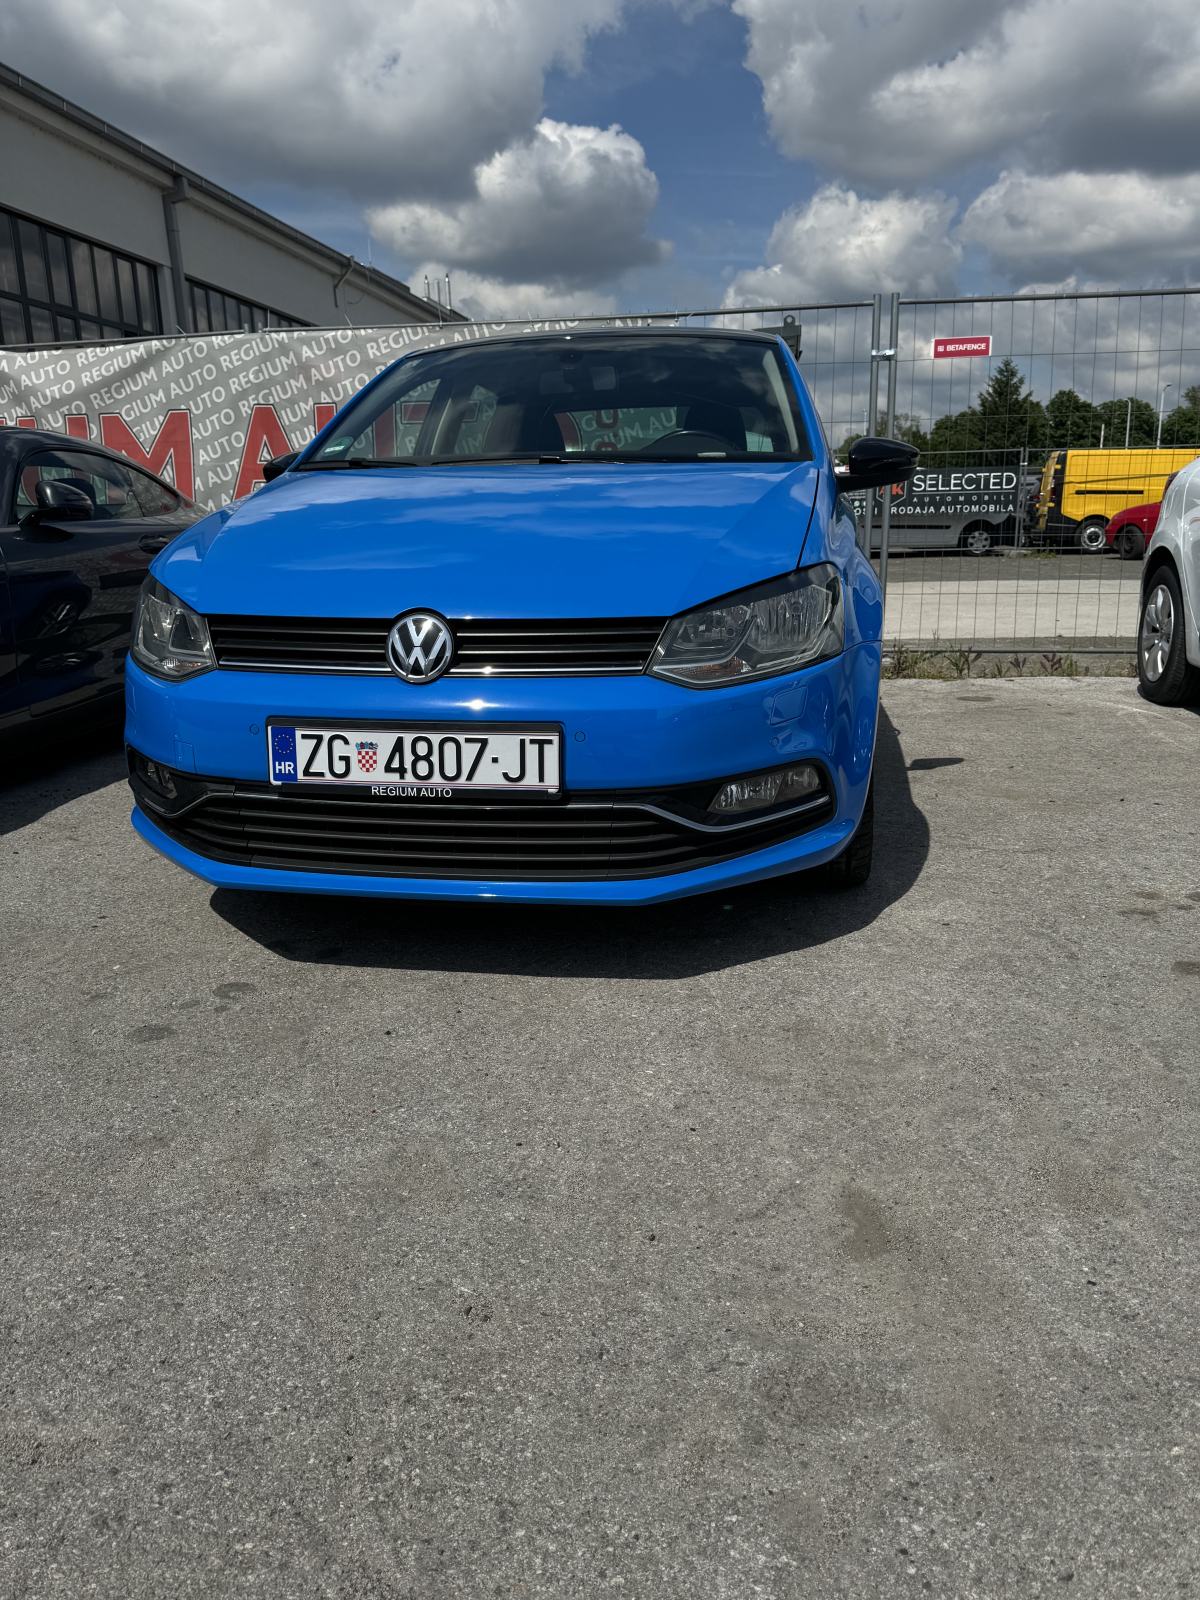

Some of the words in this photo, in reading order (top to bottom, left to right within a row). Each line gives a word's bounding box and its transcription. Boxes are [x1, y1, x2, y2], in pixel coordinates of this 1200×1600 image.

[946, 343, 987, 352] BETAFENCE
[20, 360, 70, 390] AUTO
[30, 380, 75, 412] AUTO
[81, 344, 147, 387] REGIUM
[89, 366, 158, 410] REGIUM
[161, 341, 207, 378] AUTO
[116, 388, 166, 421] GIUM
[170, 364, 217, 399] AUTO
[220, 332, 288, 372] REGIUM
[181, 386, 226, 415] UTO
[229, 351, 298, 394] REGIUM
[301, 330, 352, 362] AUTO
[310, 350, 360, 385] AUTO
[199, 431, 245, 465] AUTO
[912, 473, 1016, 491] SELECTED
[890, 505, 936, 516] RODAJA
[939, 503, 1014, 516] AUTOMOBILA
[912, 494, 1014, 503] AUTOMOBILI
[275, 761, 295, 775] HR
[300, 733, 351, 779] ZG
[371, 786, 417, 797] REGIUM
[420, 787, 452, 798] AUTO
